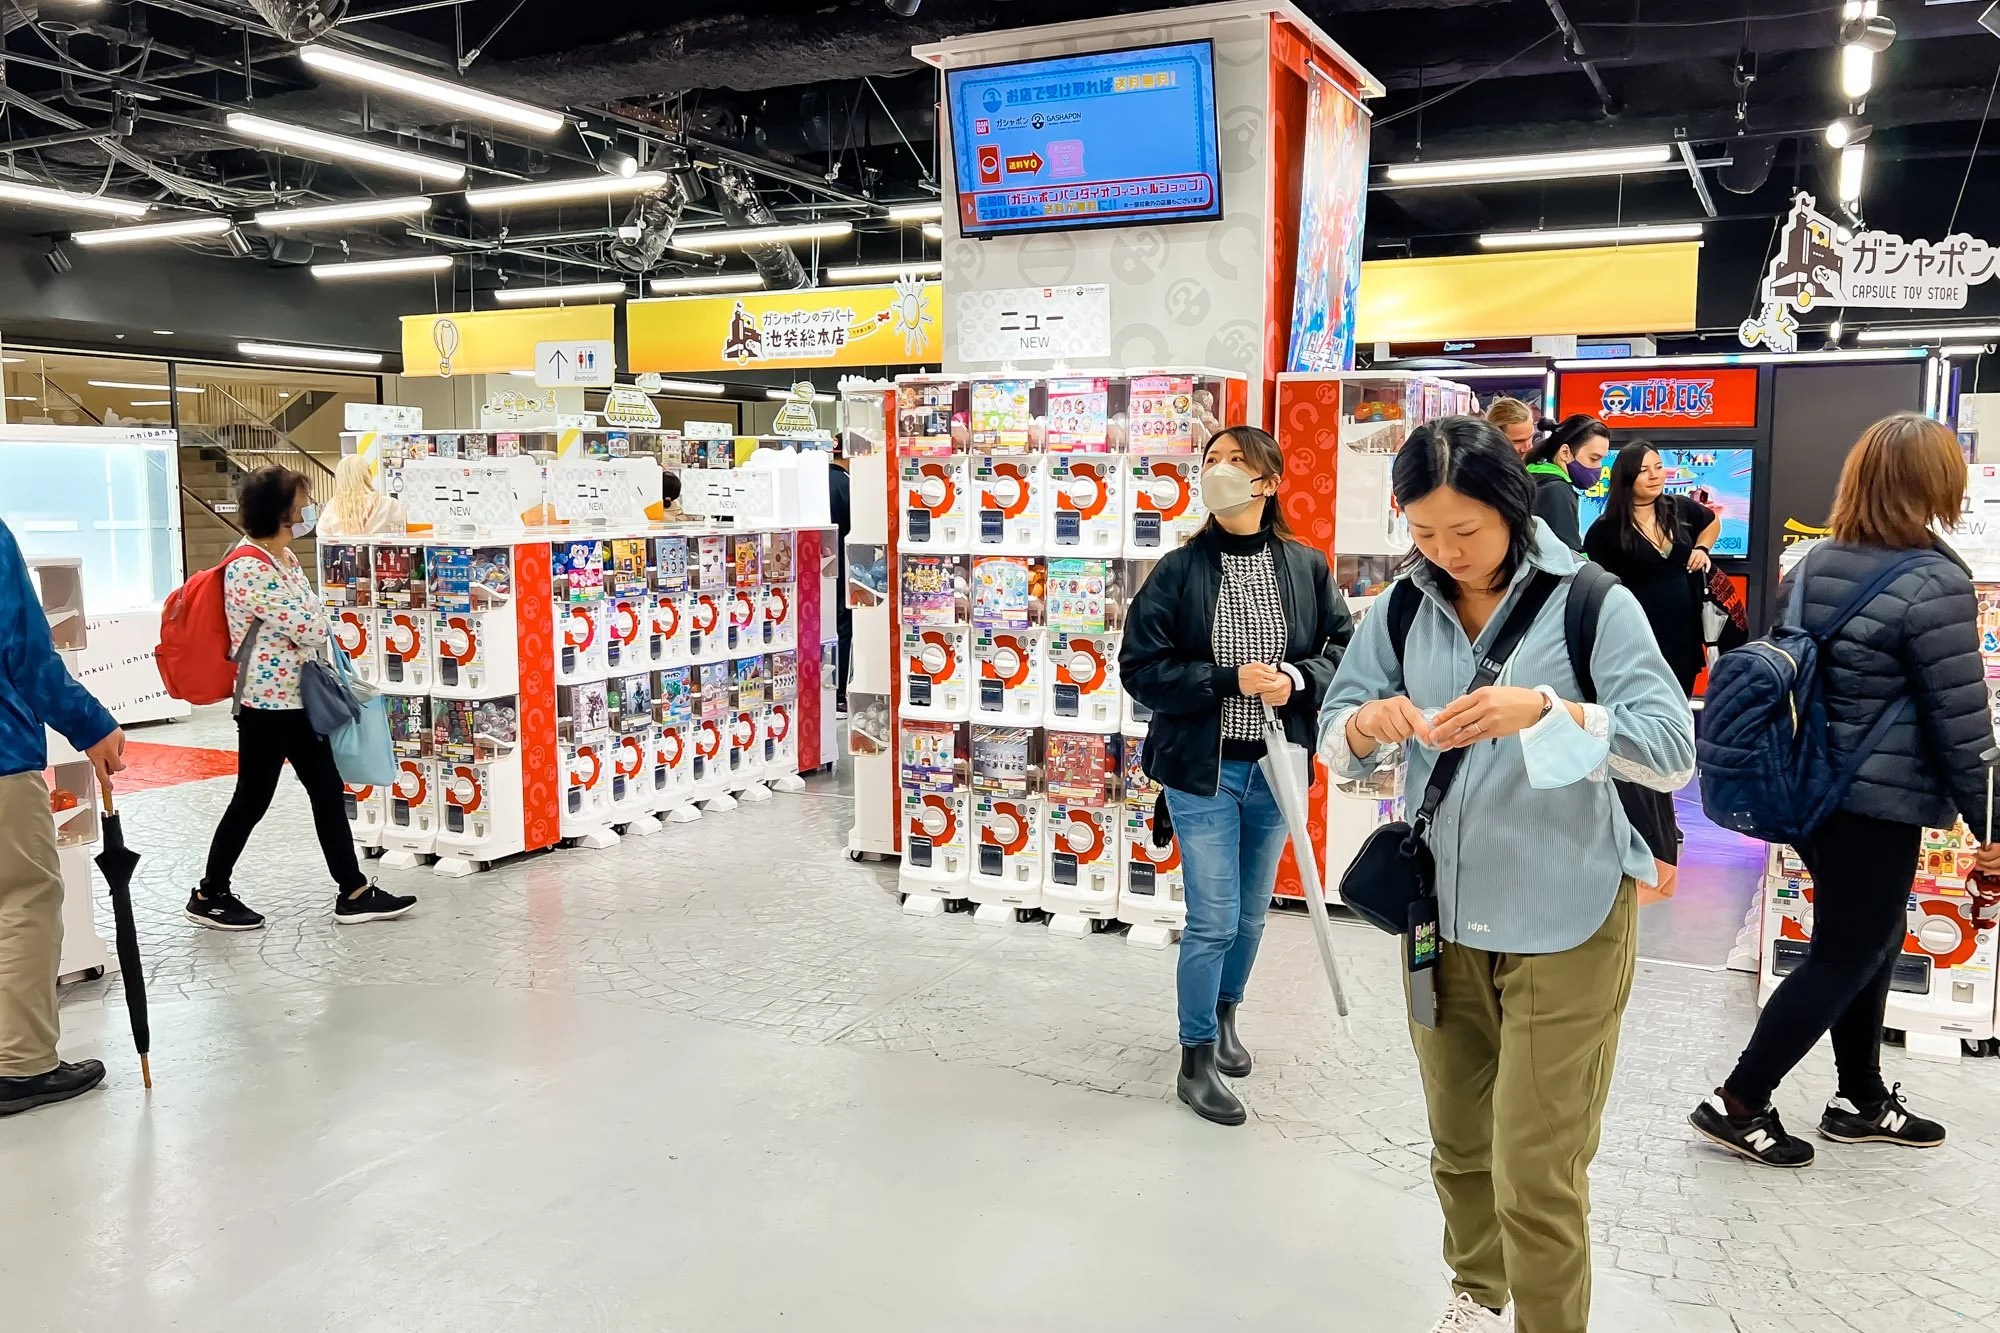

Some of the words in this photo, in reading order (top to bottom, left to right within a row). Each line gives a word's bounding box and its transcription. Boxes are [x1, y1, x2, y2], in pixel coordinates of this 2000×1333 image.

[996, 116, 1029, 128] ガシャポン
[1046, 112, 1082, 121] GASHAPON
[1853, 239, 1994, 277] ガシャポン
[1852, 285, 1896, 299] CAPSULE
[1903, 286, 1922, 299] TOY
[1928, 287, 1959, 300] STORE
[763, 309, 854, 326] ガシャポンのデパート
[1000, 311, 1064, 331] ニュー
[766, 326, 845, 348] 池袋総本店
[1020, 336, 1050, 349] NEW
[435, 486, 480, 502] ニュー
[577, 484, 609, 498] ニュー
[707, 484, 745, 498] ニュー
[449, 506, 471, 517] NEW
[588, 502, 604, 511] NEW
[719, 501, 738, 510] NEW
[1882, 1110, 1908, 1132] N
[1744, 1128, 1777, 1153] N
